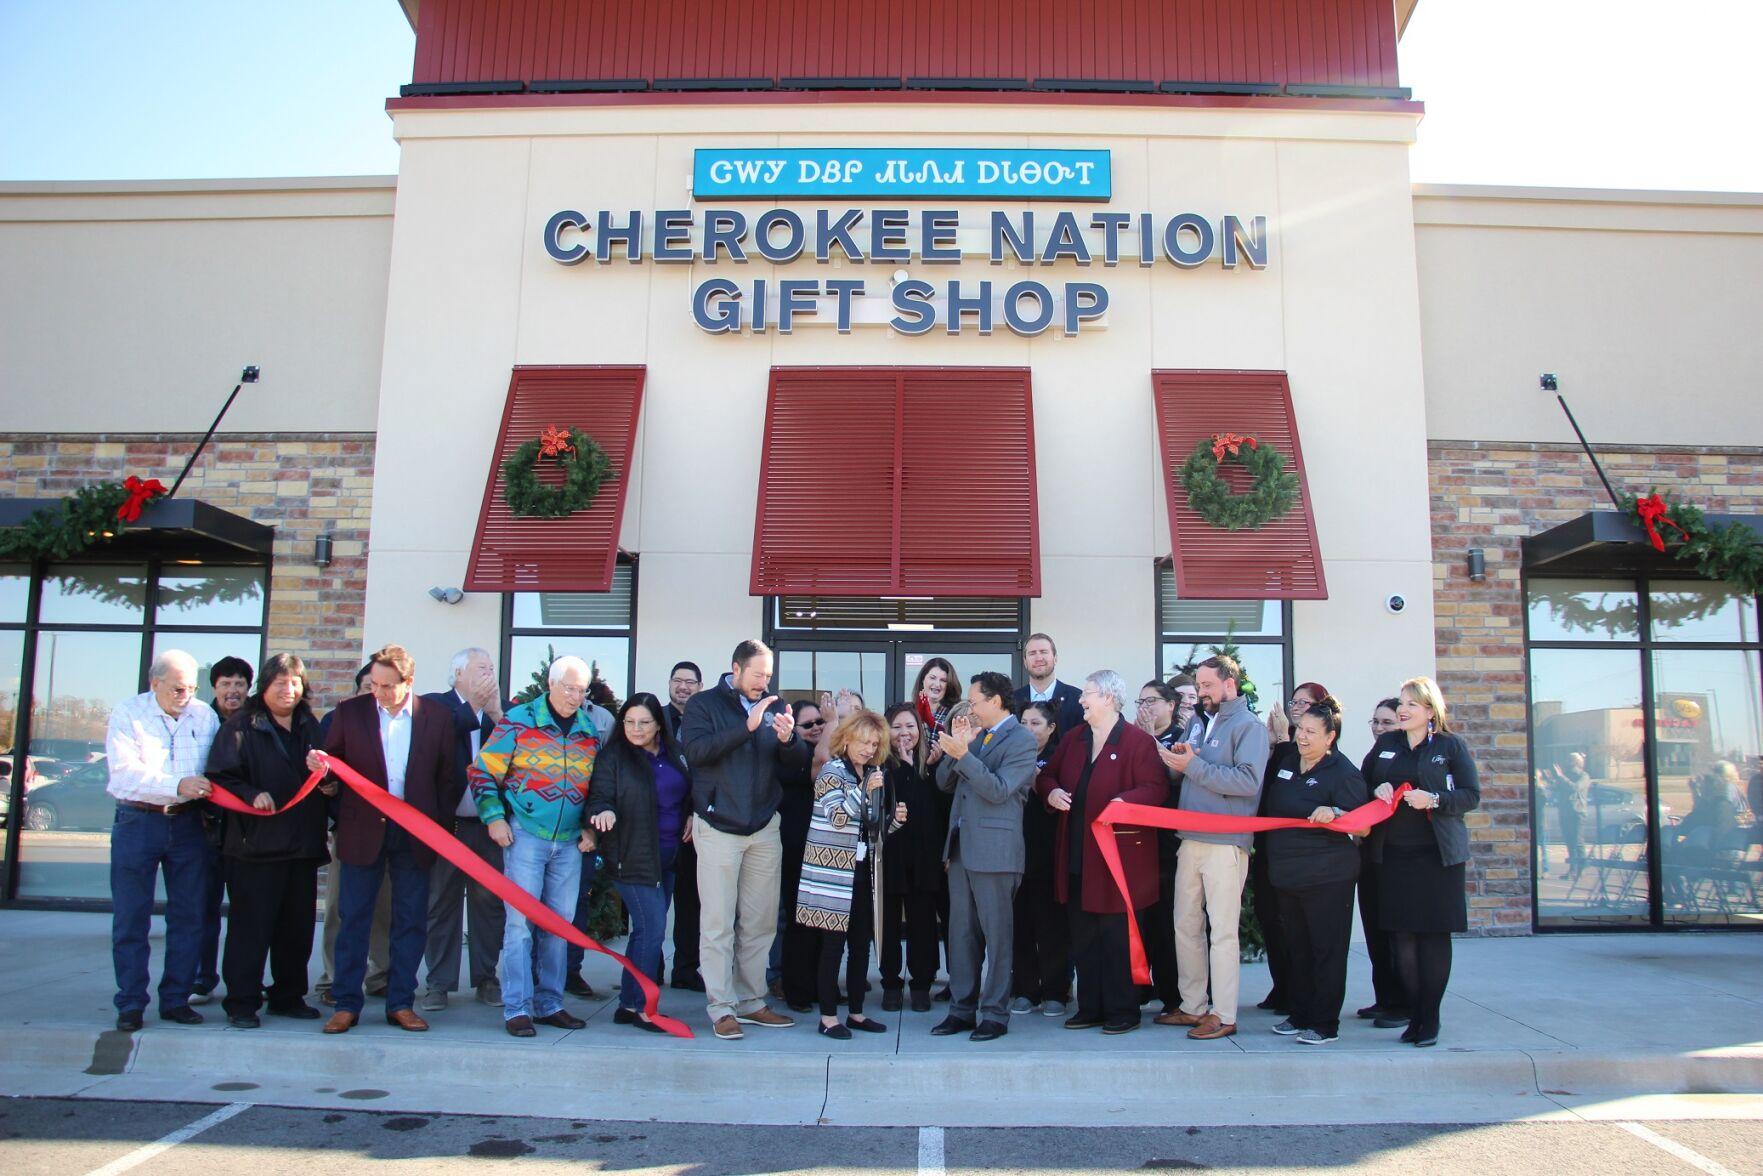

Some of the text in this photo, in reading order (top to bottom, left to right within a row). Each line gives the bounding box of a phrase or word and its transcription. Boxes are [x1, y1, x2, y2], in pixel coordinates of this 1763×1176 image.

[710, 160, 787, 184] ᏣᎳᎩ
[543, 209, 1267, 267] CHEROKEE NATION
[693, 279, 1109, 337] GIFT SHOP
